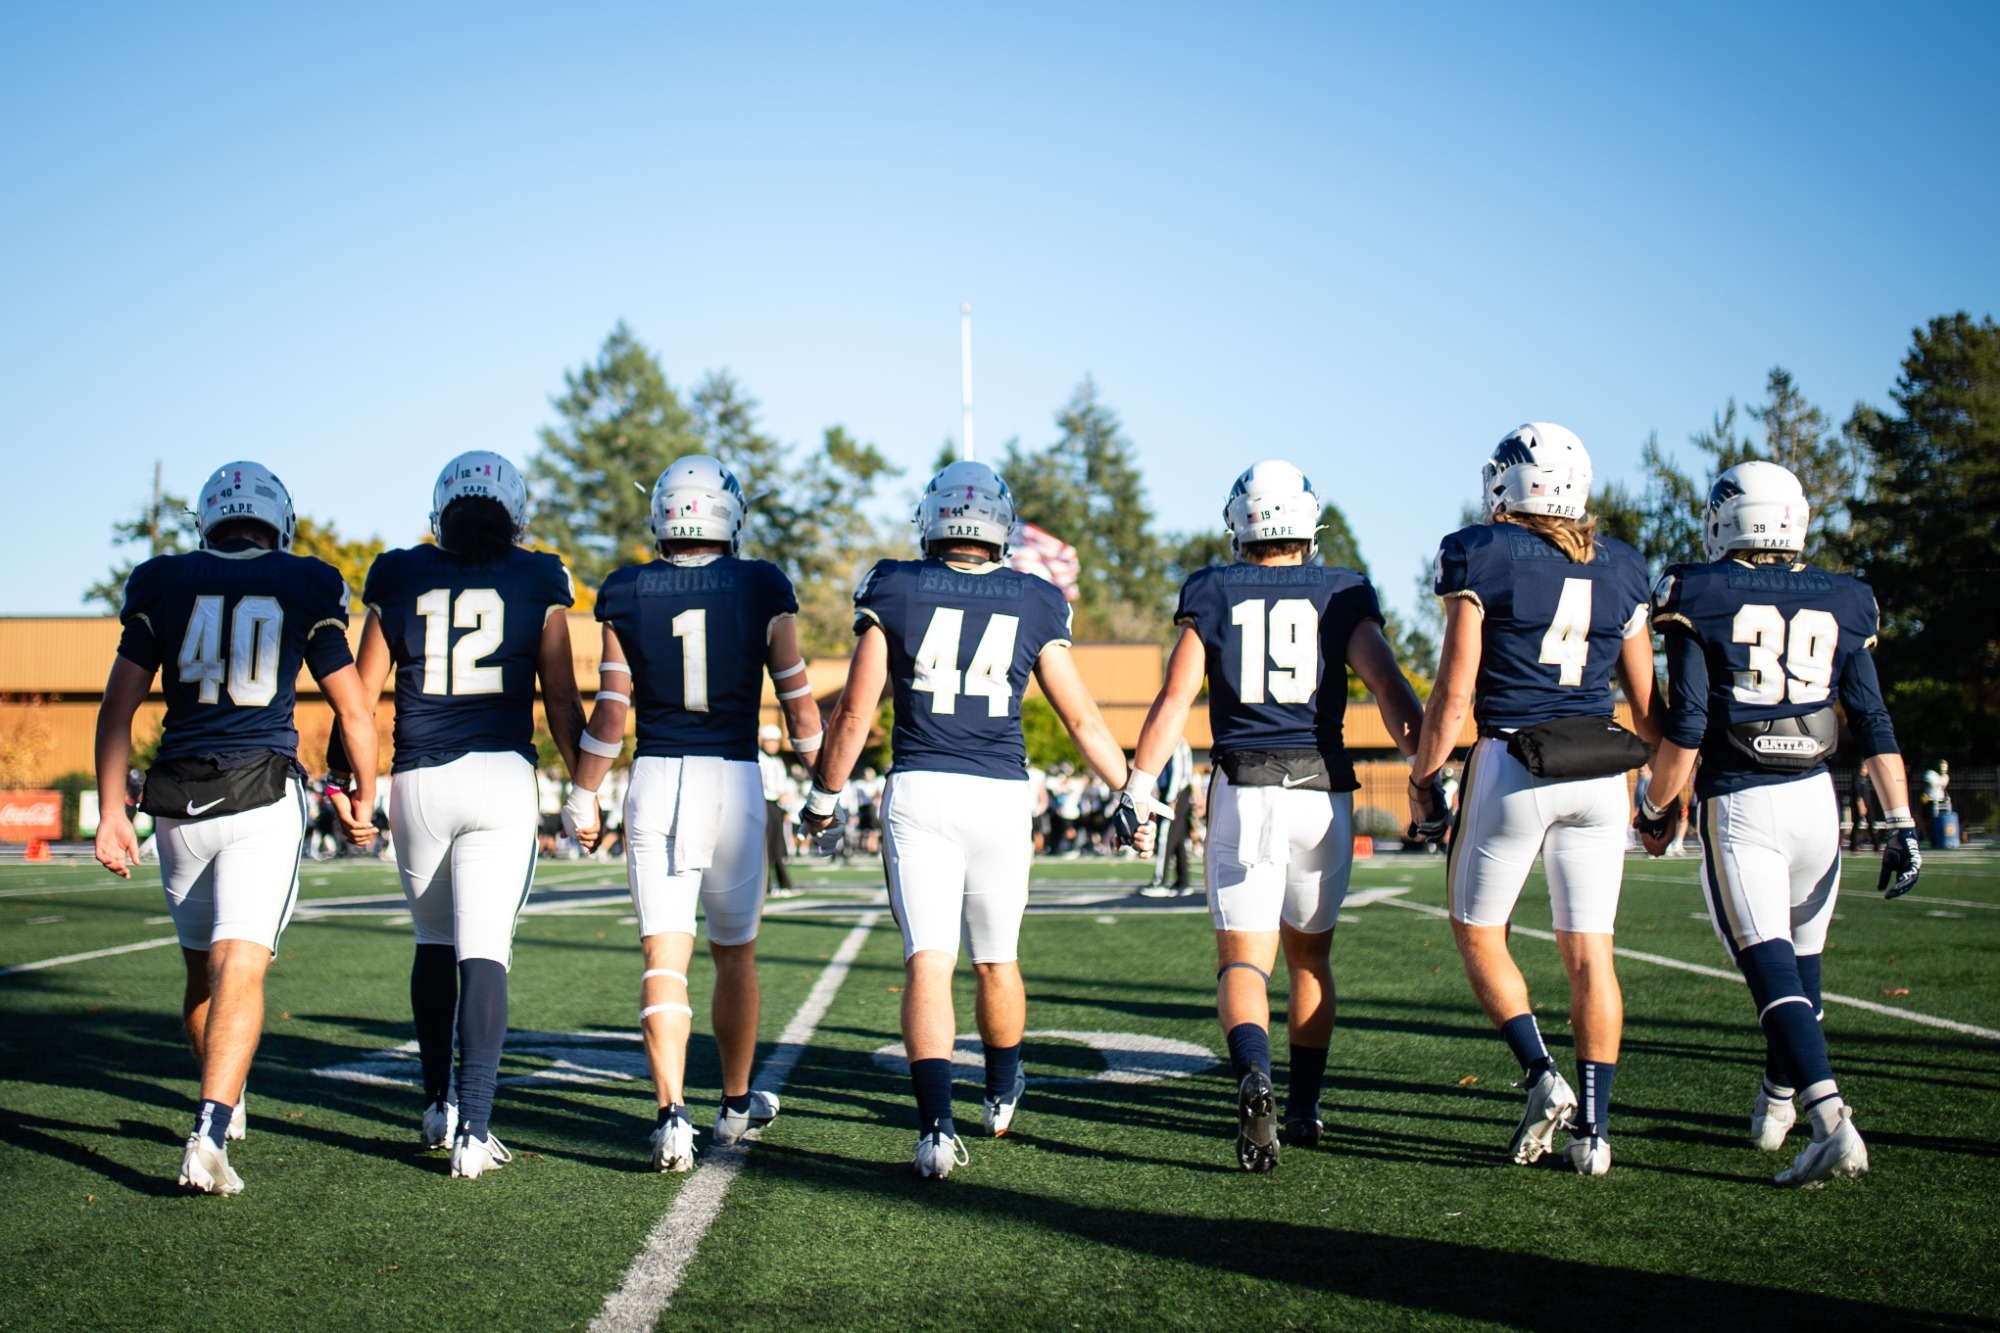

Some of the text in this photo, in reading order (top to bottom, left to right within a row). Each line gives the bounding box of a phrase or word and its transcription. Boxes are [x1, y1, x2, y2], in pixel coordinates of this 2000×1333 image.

[461, 469, 471, 479] 12
[220, 488, 233, 498] 40
[1554, 486, 1560, 495] 4
[951, 507, 964, 516] 44
[1261, 510, 1271, 520] 19
[1753, 524, 1765, 533] 39
[641, 569, 735, 592] BRUINS
[923, 570, 1020, 597] BRUINS
[1230, 567, 1323, 583] BRUINS
[1734, 567, 1832, 591] BRUINS
[416, 588, 505, 695] 12
[1538, 578, 1592, 686] 4
[178, 595, 284, 707] 40
[672, 609, 709, 712] 1
[911, 606, 1020, 717] 44
[1231, 599, 1319, 704] 19
[1732, 604, 1839, 705] 39
[1760, 740, 1813, 750] BATTLE
